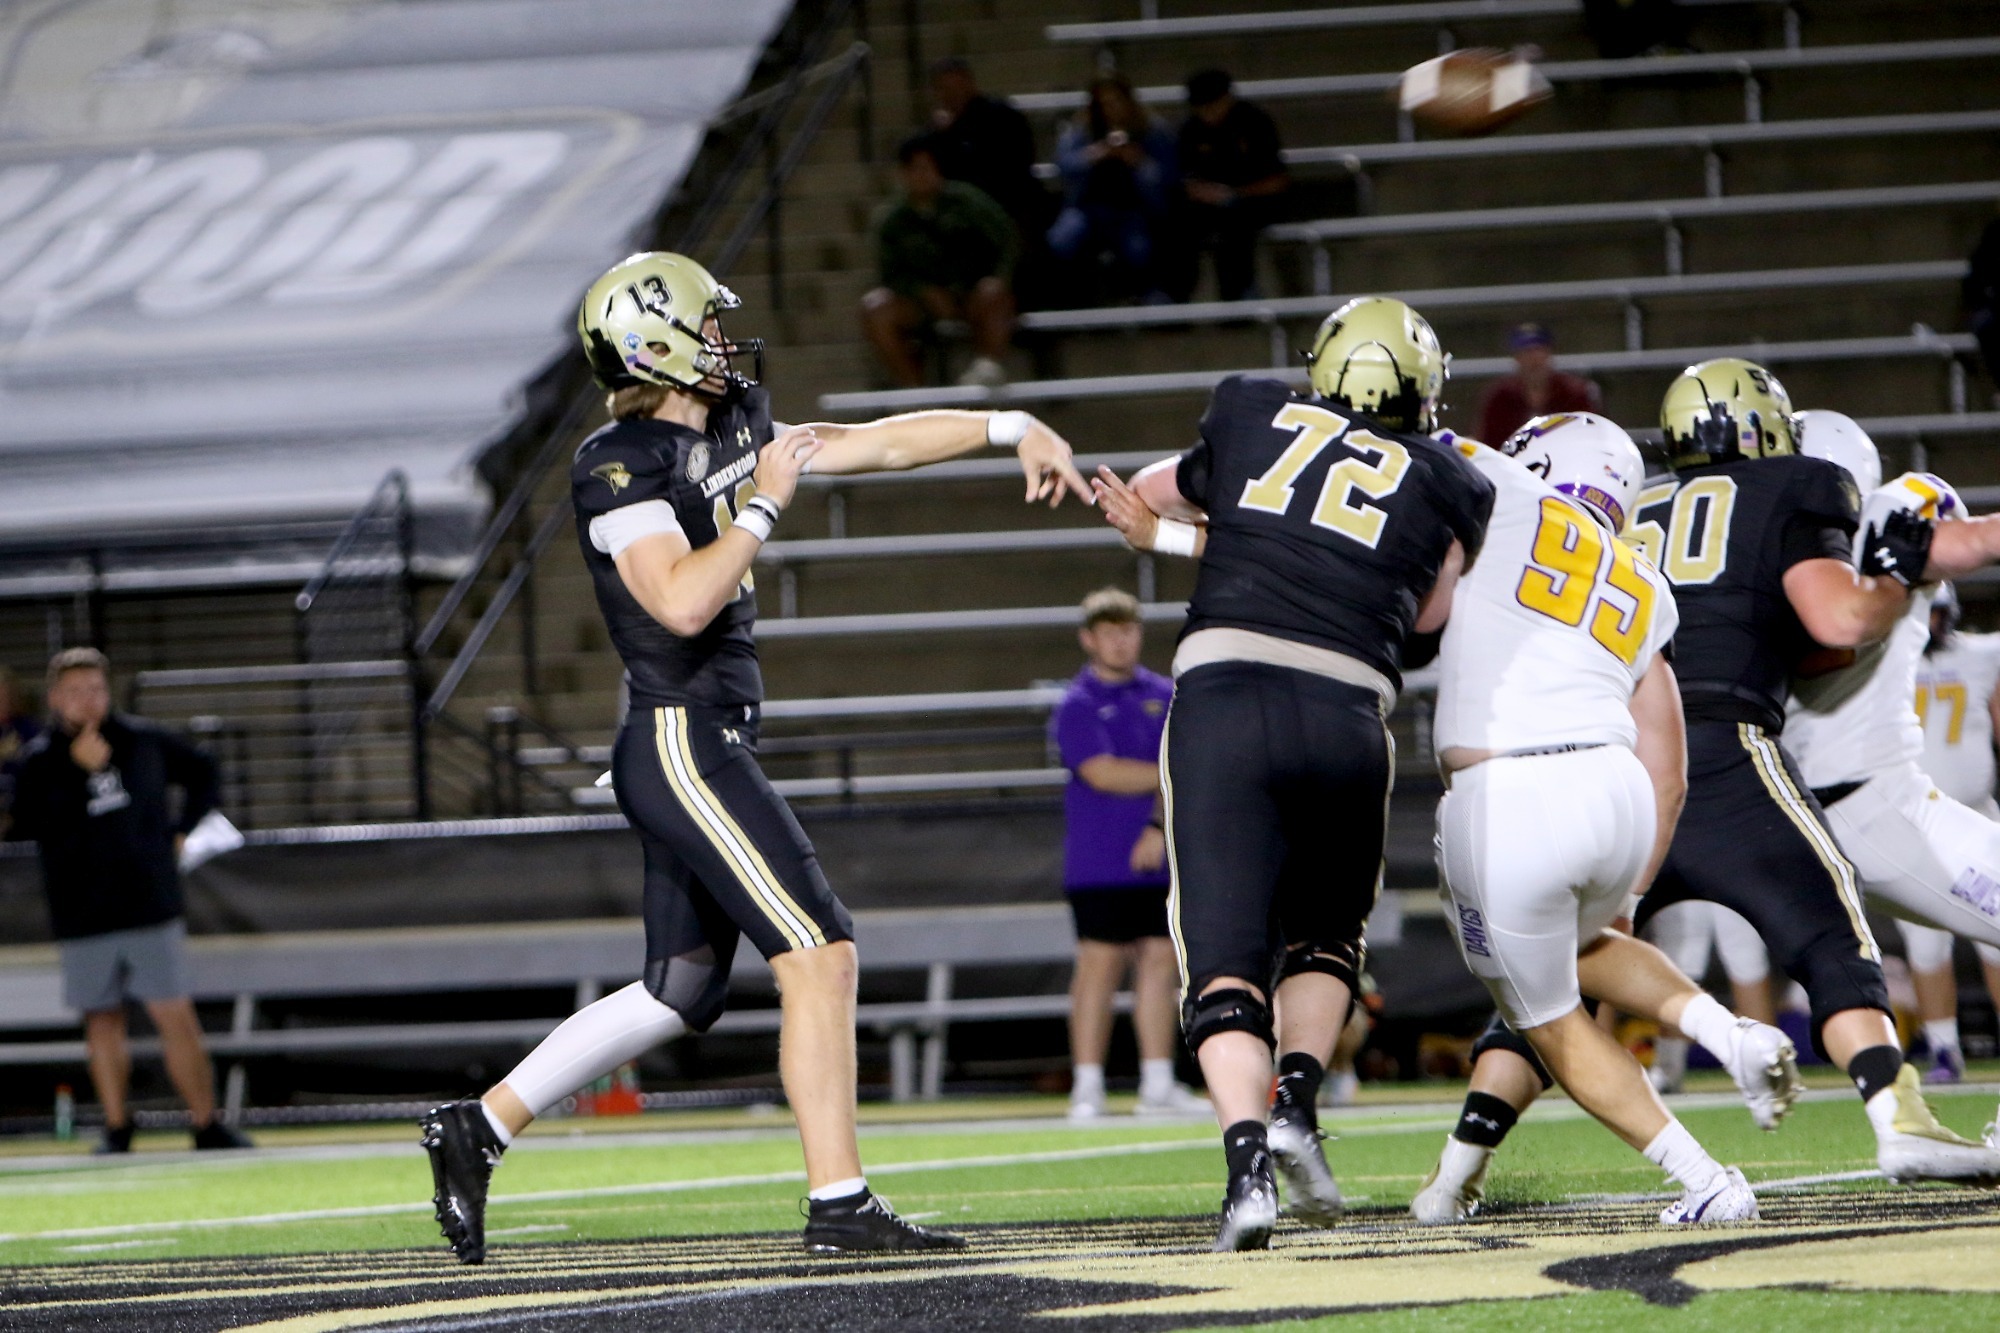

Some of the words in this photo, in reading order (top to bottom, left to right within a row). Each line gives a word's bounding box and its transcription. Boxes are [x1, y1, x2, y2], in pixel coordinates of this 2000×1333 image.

[625, 274, 673, 317] 13
[1238, 402, 1412, 549] 72
[1516, 496, 1657, 667] 95
[1458, 903, 1490, 957] DAWGS
